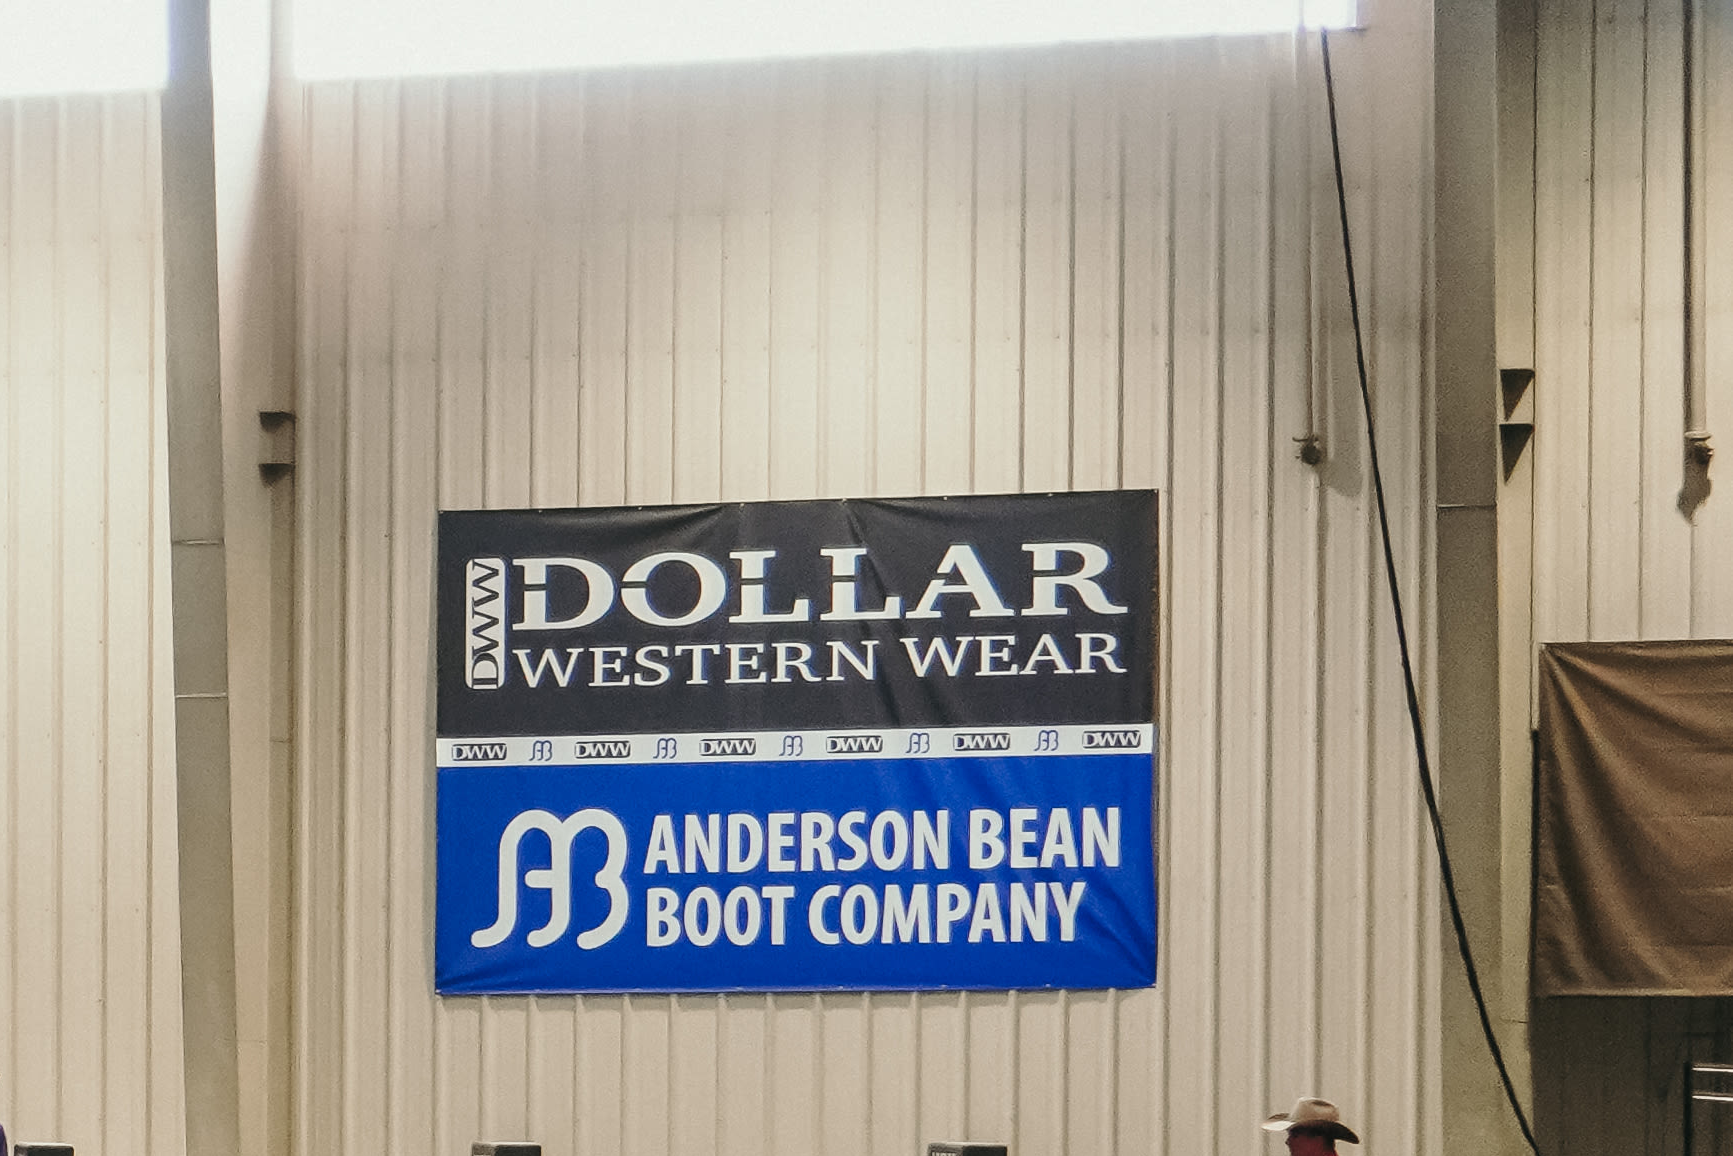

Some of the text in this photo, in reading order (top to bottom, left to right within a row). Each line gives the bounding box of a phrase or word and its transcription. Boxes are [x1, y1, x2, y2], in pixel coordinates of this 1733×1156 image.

[512, 542, 1129, 631] DOLLAR
[472, 559, 499, 689] DWW
[512, 633, 1128, 689] WESTERN WEAR
[452, 743, 507, 761] DWW
[574, 741, 630, 759] DWW
[699, 738, 756, 756] DWW
[826, 735, 883, 754] DWW
[953, 732, 1010, 751] DWW
[1082, 730, 1140, 749] DWW
[644, 807, 1120, 876] ANDERSON BEAN
[647, 882, 1086, 948] BOOT COMPANY
